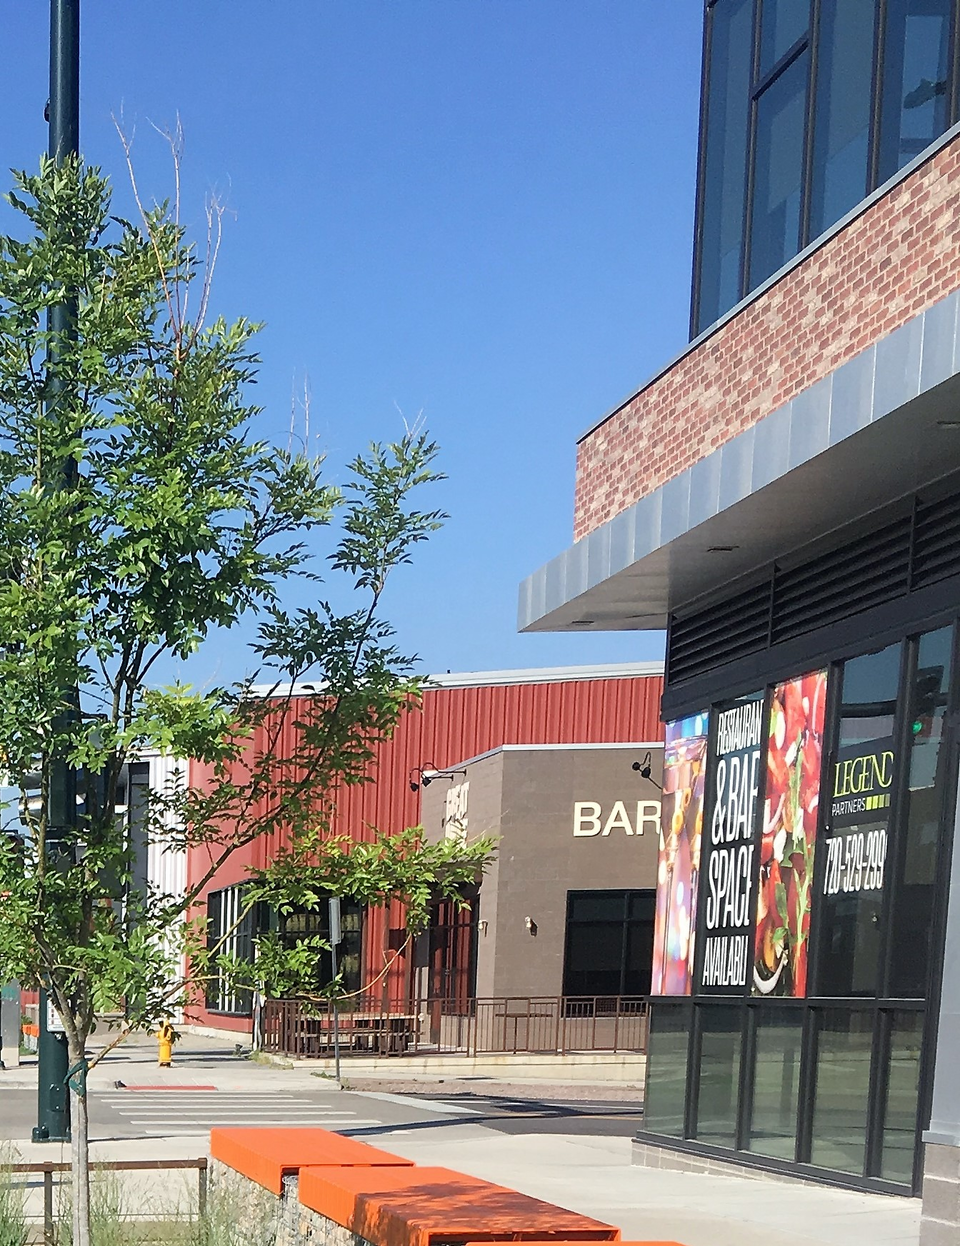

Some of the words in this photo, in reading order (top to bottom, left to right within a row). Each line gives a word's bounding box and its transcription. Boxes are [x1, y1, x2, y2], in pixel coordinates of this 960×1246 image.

[716, 699, 764, 756] RESTAURAN
[832, 750, 894, 798] LEGEND
[573, 800, 662, 837] BAR
[831, 797, 866, 817] PARTNERS
[823, 829, 889, 895] 720-529-299
